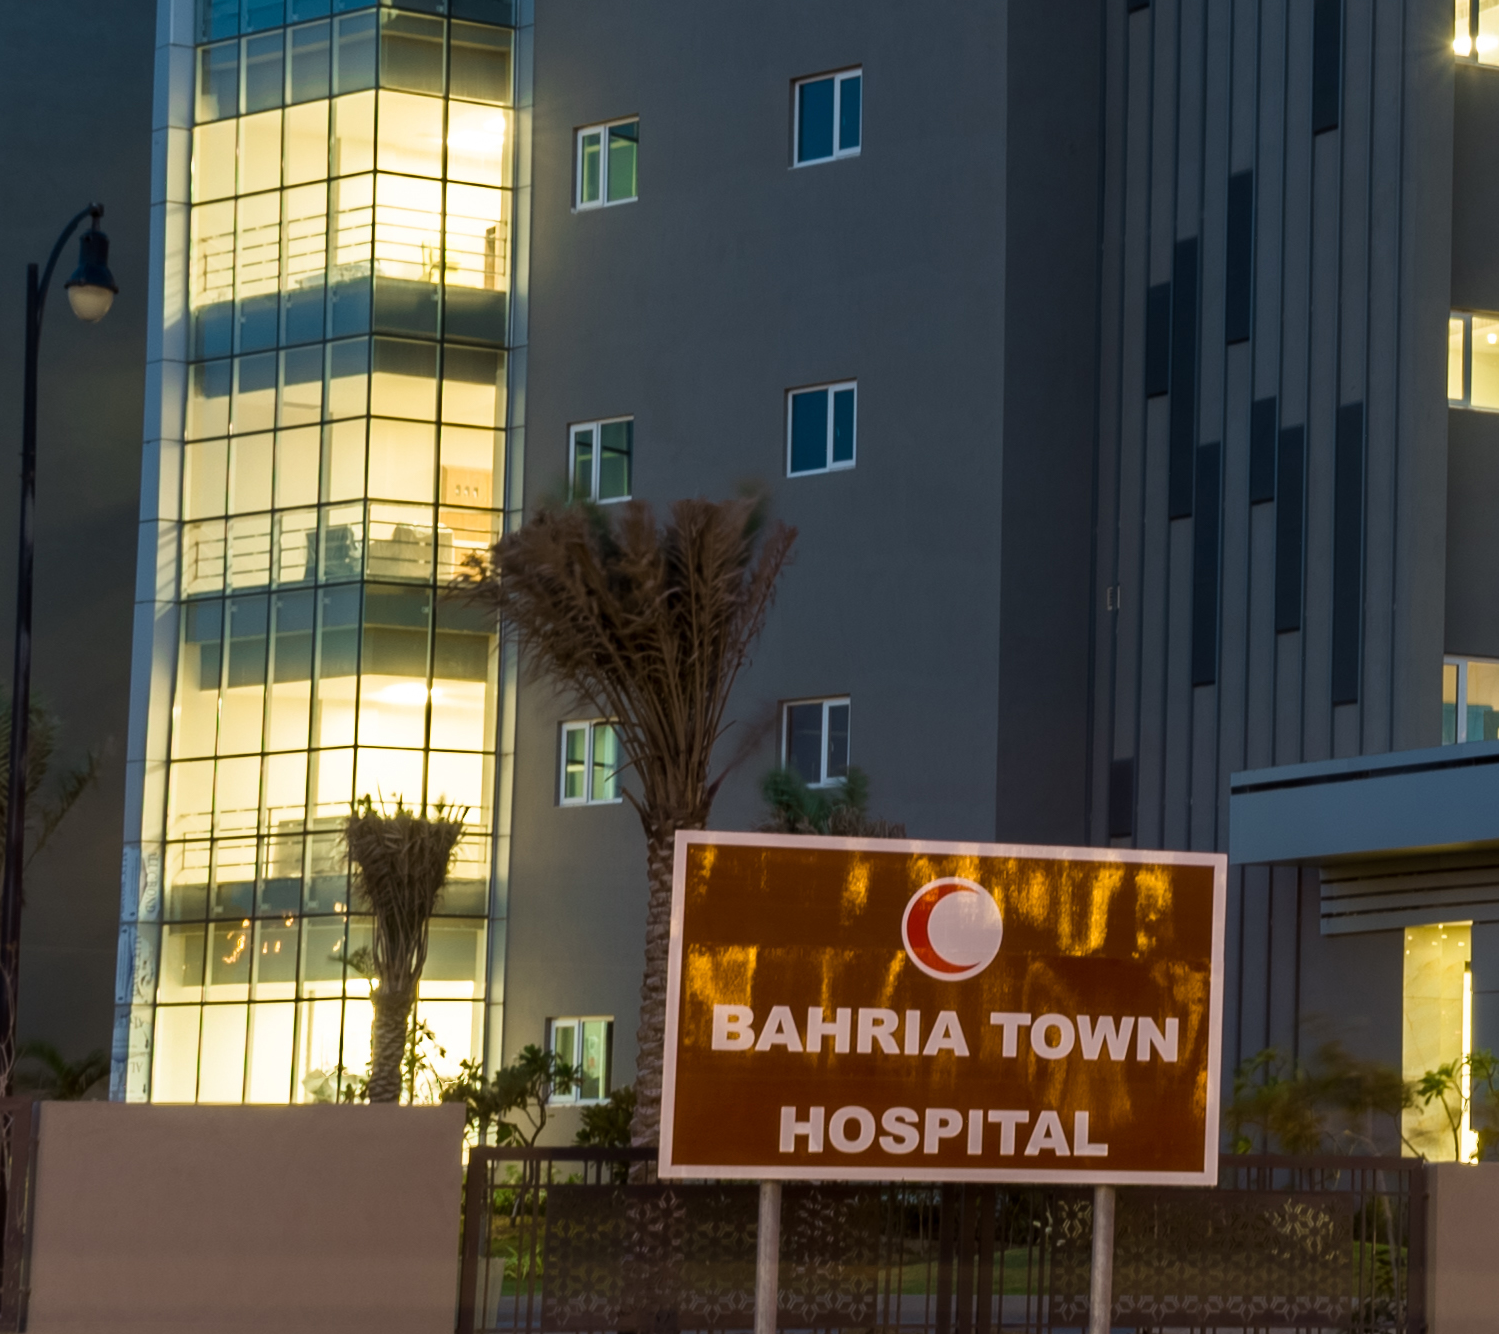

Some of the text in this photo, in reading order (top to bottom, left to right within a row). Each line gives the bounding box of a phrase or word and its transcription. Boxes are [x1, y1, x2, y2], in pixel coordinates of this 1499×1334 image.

[711, 1004, 1179, 1063] BAHRIA TOWN
[778, 1106, 1108, 1158] HOSPITAL
